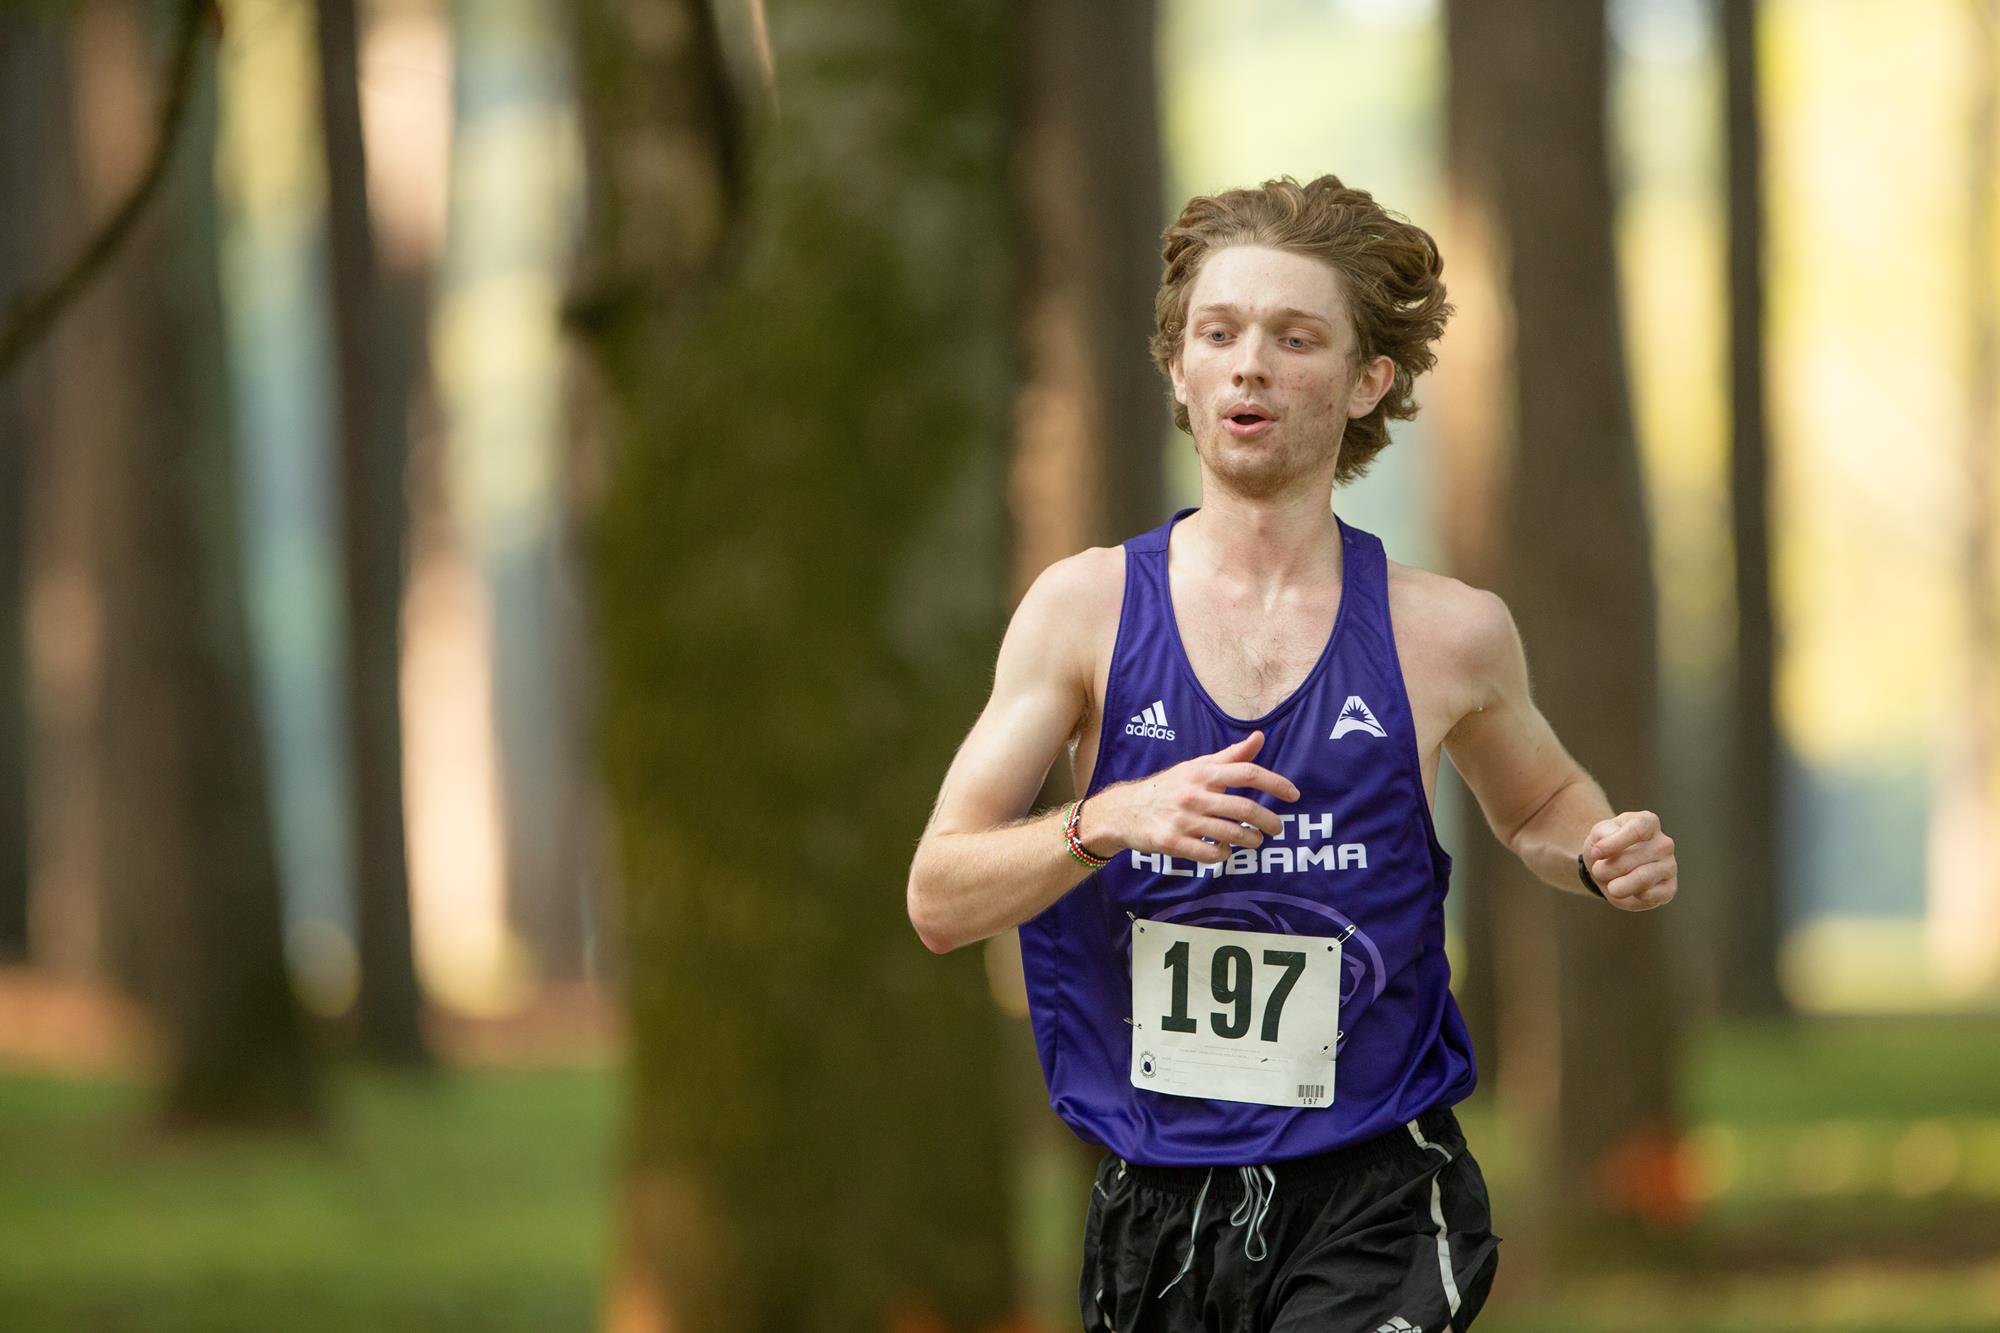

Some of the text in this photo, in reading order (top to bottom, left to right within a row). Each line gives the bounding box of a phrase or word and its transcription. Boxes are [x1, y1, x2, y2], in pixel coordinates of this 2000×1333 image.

[1125, 722, 1176, 741] adidas
[1161, 940, 1307, 1043] 197
[1303, 1097, 1318, 1105] 197
